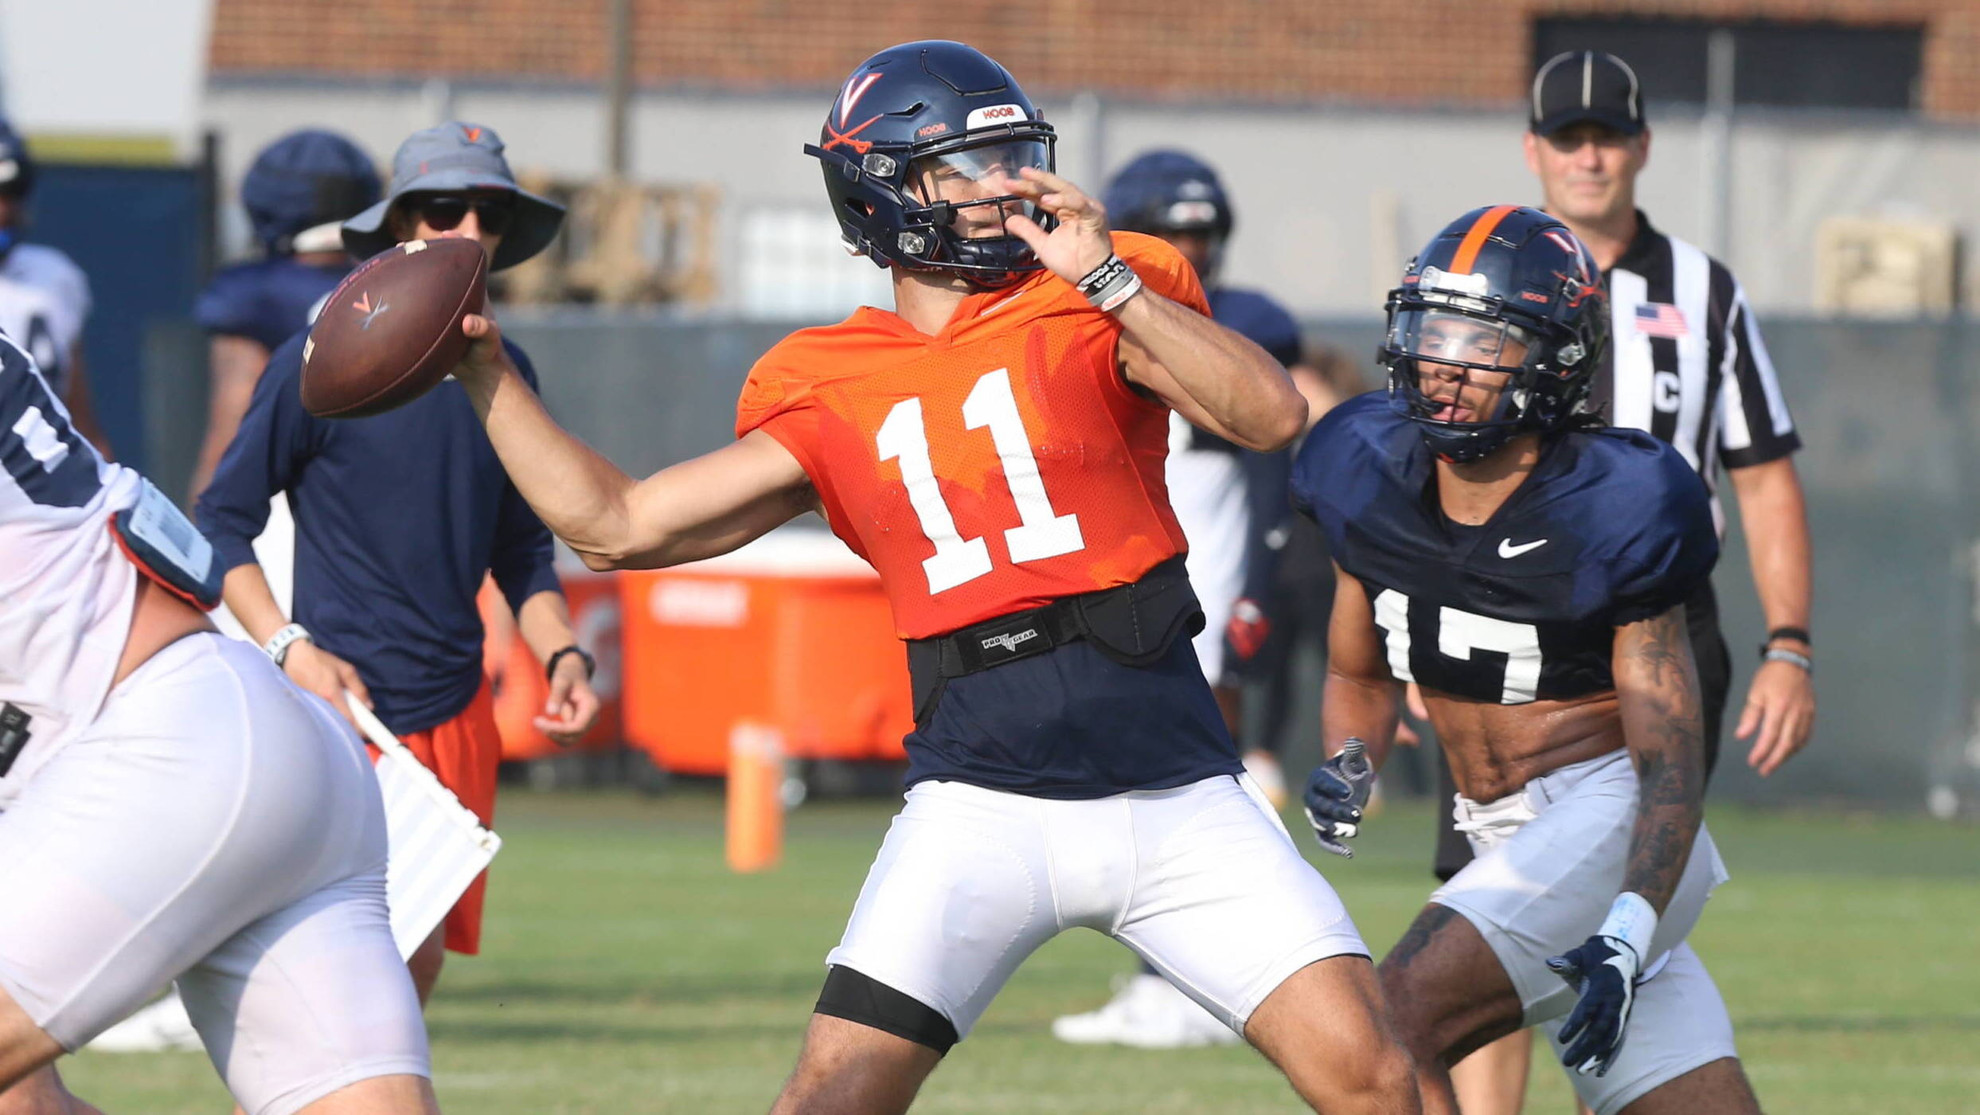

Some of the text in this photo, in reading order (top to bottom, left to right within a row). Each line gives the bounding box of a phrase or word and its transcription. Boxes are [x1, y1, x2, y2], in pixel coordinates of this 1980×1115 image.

[983, 106, 1015, 120] HOOS
[918, 123, 947, 137] HOOS
[1654, 370, 1680, 413] C
[875, 367, 1086, 596] 11
[981, 629, 1038, 649] PRO GEAR
[1373, 588, 1543, 705] 17
